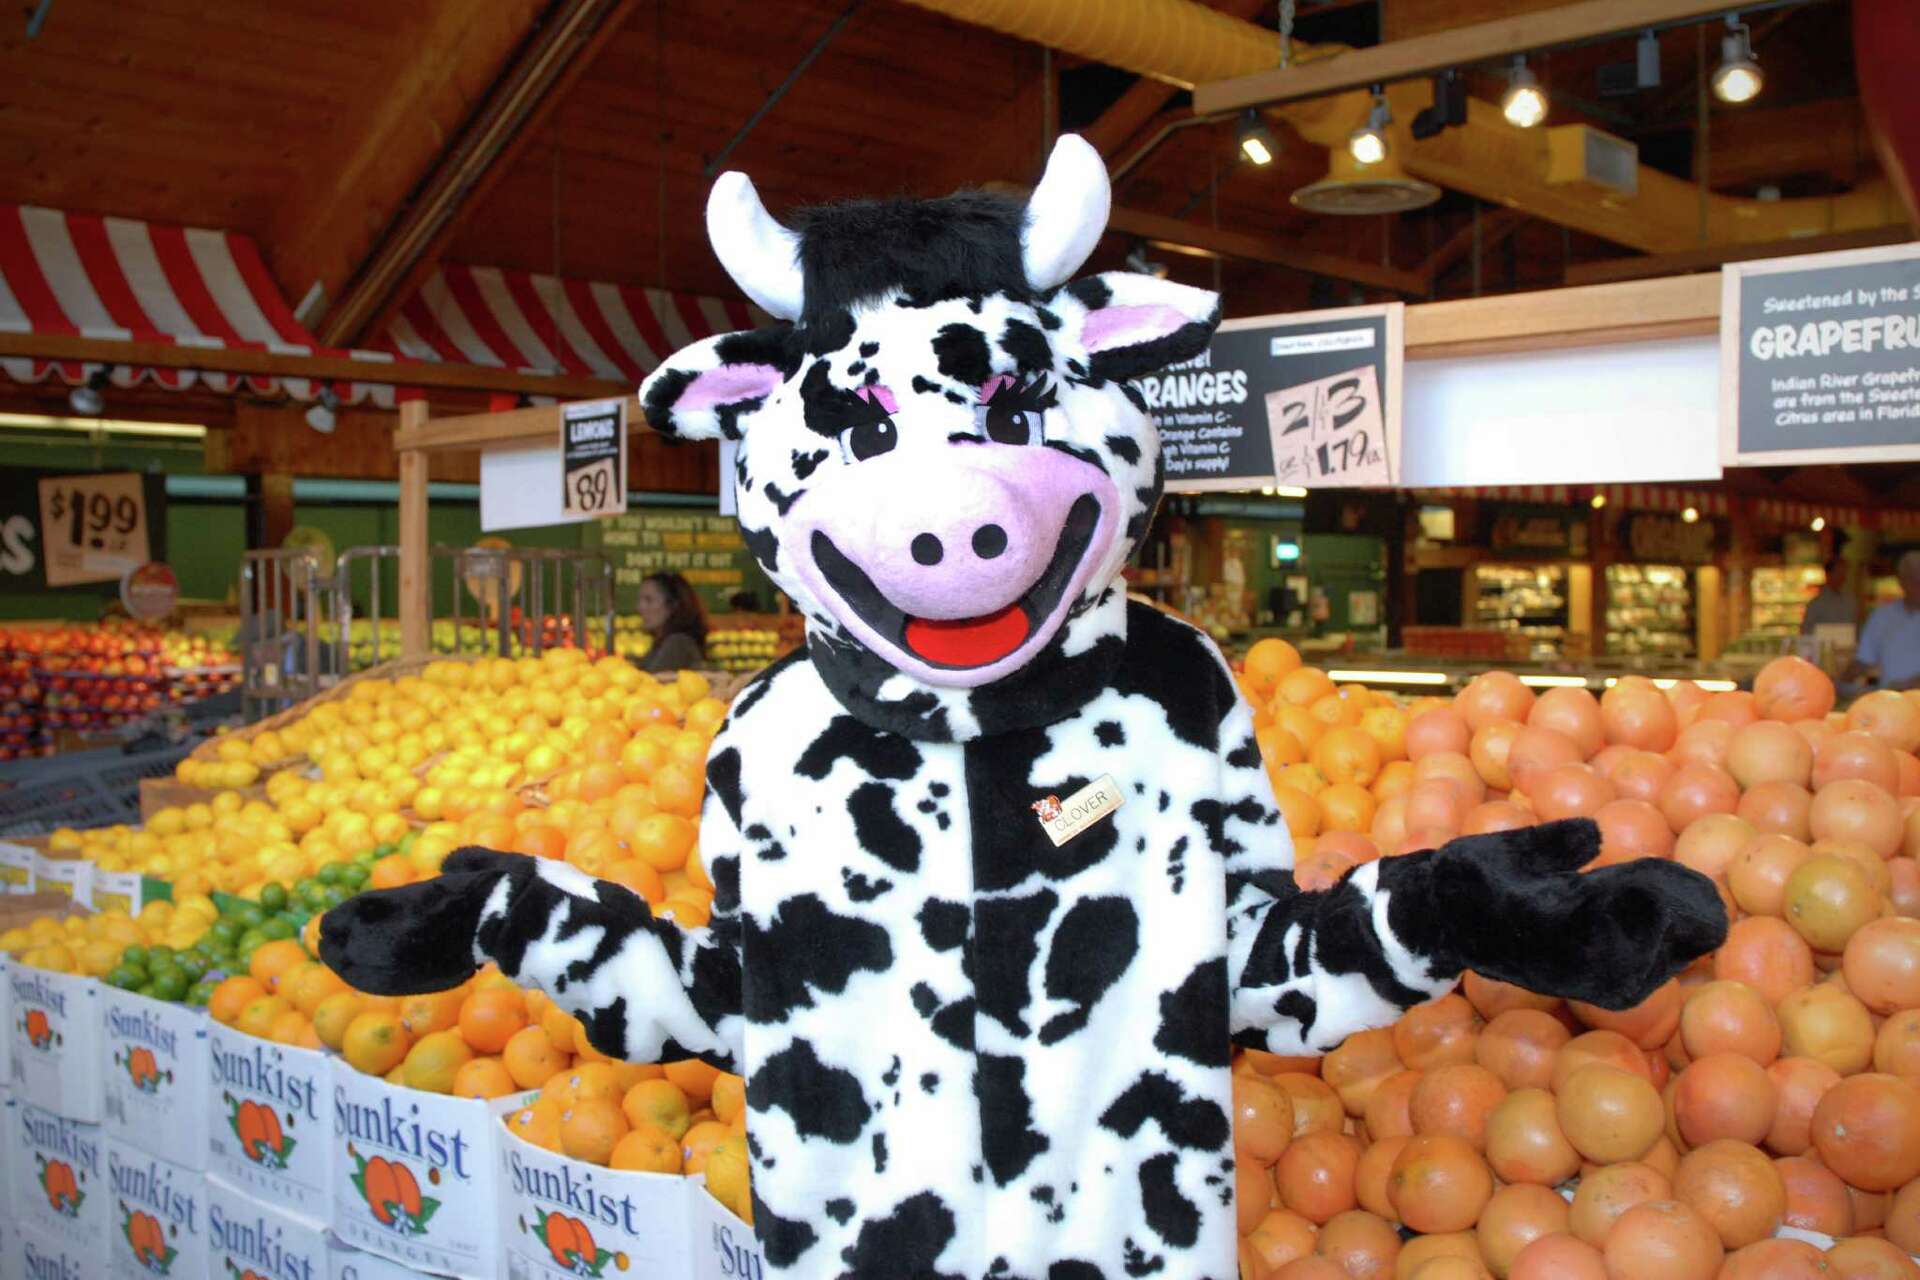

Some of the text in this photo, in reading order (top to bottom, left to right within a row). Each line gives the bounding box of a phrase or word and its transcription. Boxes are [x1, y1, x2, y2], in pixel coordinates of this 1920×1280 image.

[1763, 289, 1852, 314] Sweetened
[1858, 289, 1876, 308] by
[1880, 287, 1907, 302] the
[1131, 369, 1248, 409] RANGES
[1771, 376, 1816, 392] Indian
[1820, 373, 1858, 390] River
[1774, 397, 1797, 408] are
[1802, 392, 1836, 406] from
[1840, 391, 1864, 404] the
[1175, 411, 1213, 424] Vitamin
[1198, 425, 1243, 440] Contains
[1775, 411, 1819, 426] Citrus
[1822, 410, 1855, 423] area
[1859, 406, 1873, 420] in
[1180, 442, 1218, 455] Vitamin
[1219, 441, 1231, 454] C
[577, 468, 608, 512] 89
[1055, 791, 1108, 831] CLOVER
[109, 1005, 178, 1060] Sunkist
[210, 1036, 318, 1121] Sunkist
[22, 1106, 100, 1180] Sunkist
[334, 1084, 472, 1180] Sunkist
[106, 1150, 198, 1234] Sunkist
[510, 1149, 641, 1236] Sunkist
